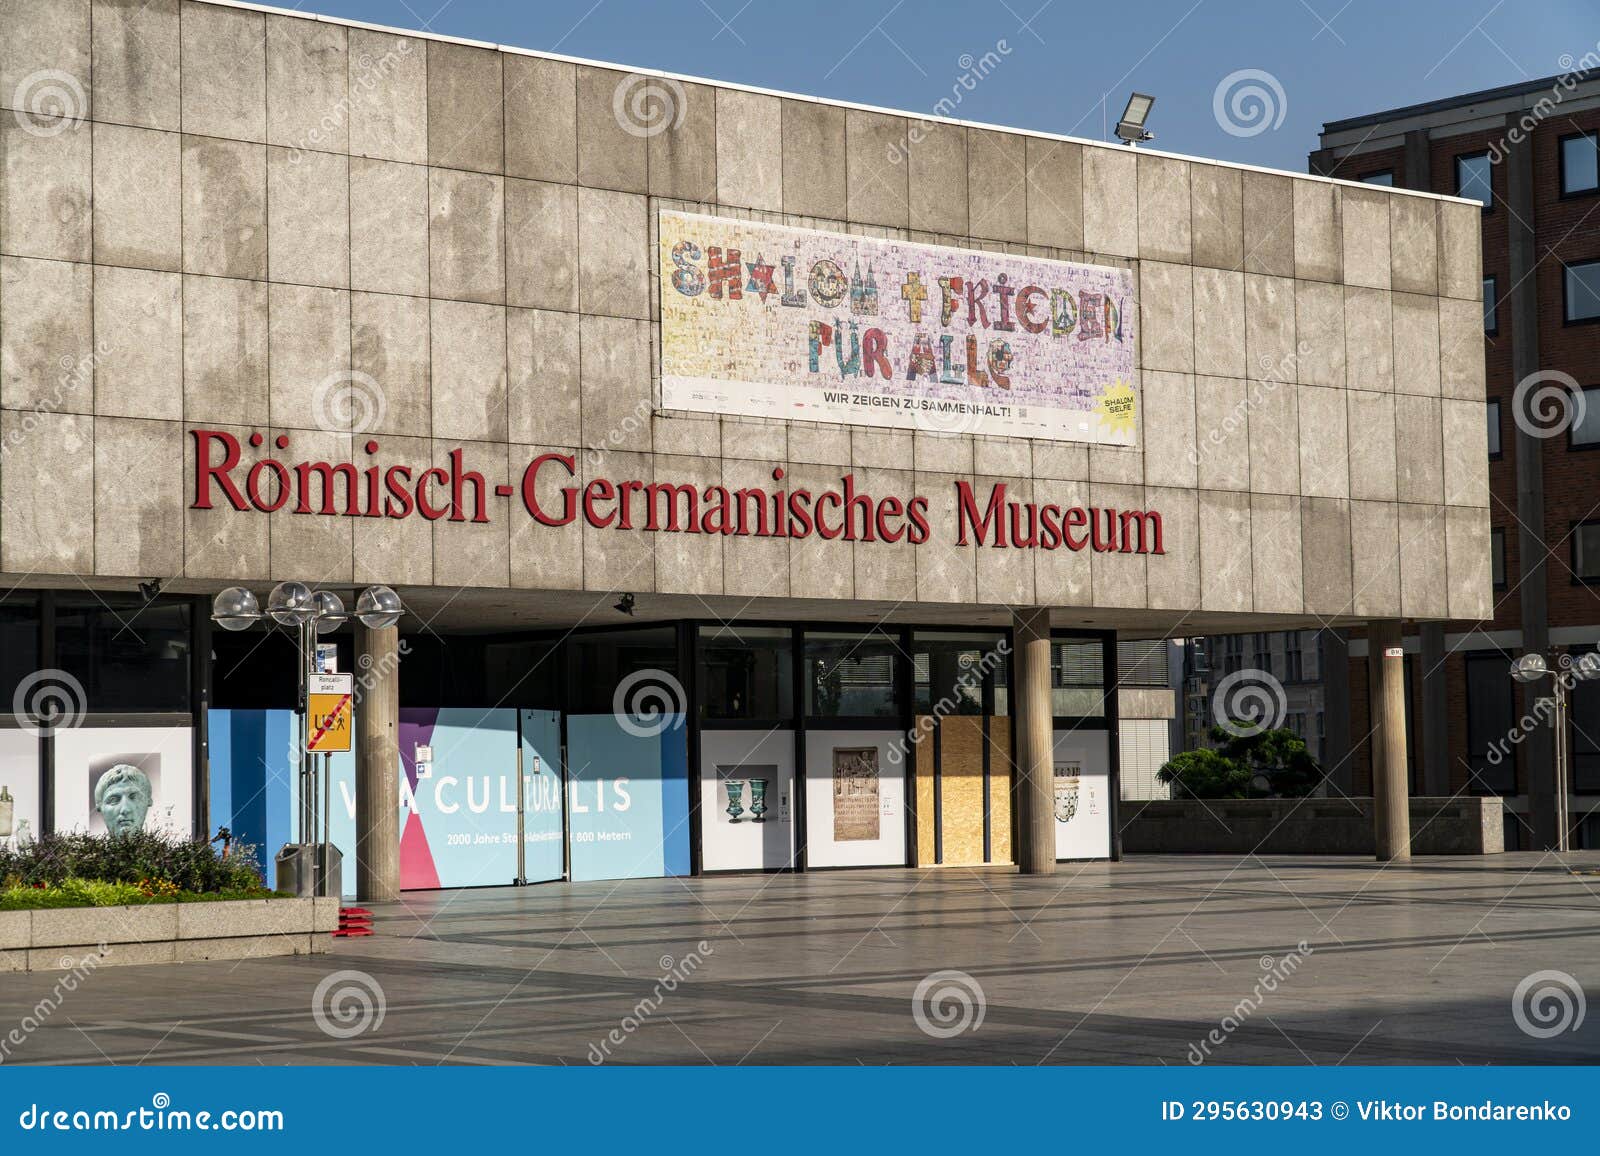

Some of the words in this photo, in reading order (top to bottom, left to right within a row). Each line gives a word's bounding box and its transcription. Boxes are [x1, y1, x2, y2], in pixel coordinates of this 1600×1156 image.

[823, 391, 849, 405] WIR
[852, 394, 900, 409] ZEIGEN
[904, 398, 1012, 417] ZUSAMMENHALT!
[1104, 396, 1134, 407] SHALOM
[190, 429, 930, 544] Römisch-Germanisches
[956, 480, 1166, 555] Museum
[338, 776, 419, 819] VA
[434, 776, 631, 814] CULTURALIS
[447, 833, 471, 845] 2000
[473, 832, 501, 845] Jahre
[576, 831, 595, 842] 800
[597, 831, 632, 842] Metern
